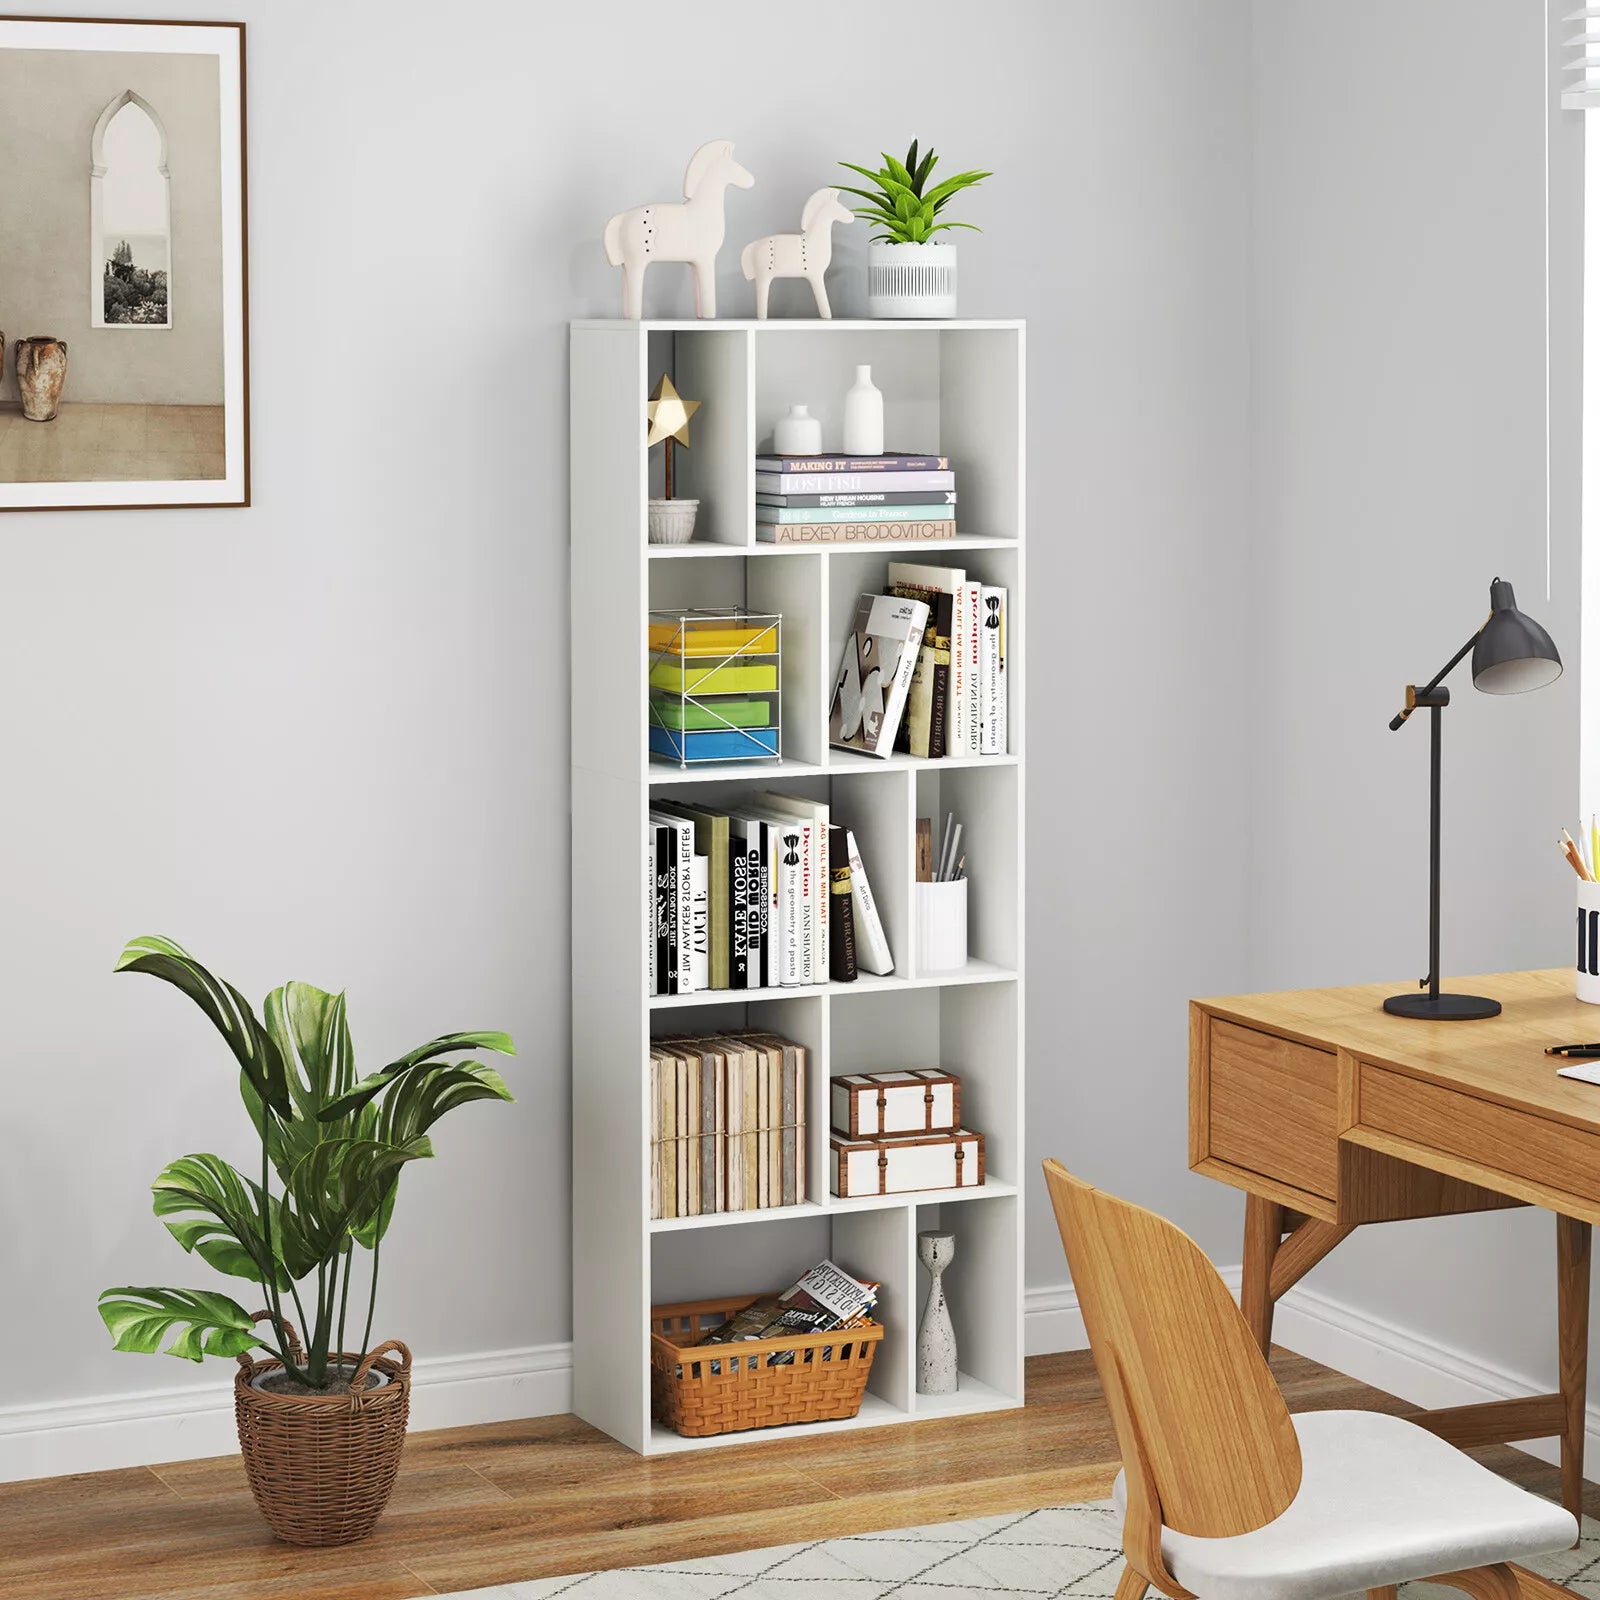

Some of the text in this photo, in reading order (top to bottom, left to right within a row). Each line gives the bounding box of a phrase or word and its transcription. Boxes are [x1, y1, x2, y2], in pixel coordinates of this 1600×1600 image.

[790, 461, 833, 471] MAKING
[835, 461, 846, 470] IT
[785, 475, 861, 491] LOST FISH
[832, 510, 867, 519] Gardens
[879, 509, 909, 518] France
[780, 526, 840, 542] ALEXEY
[845, 523, 945, 540] BRODOVITCH
[821, 866, 826, 878] HA
[790, 938, 796, 947] of
[842, 899, 854, 975] RAY BRADBURY
